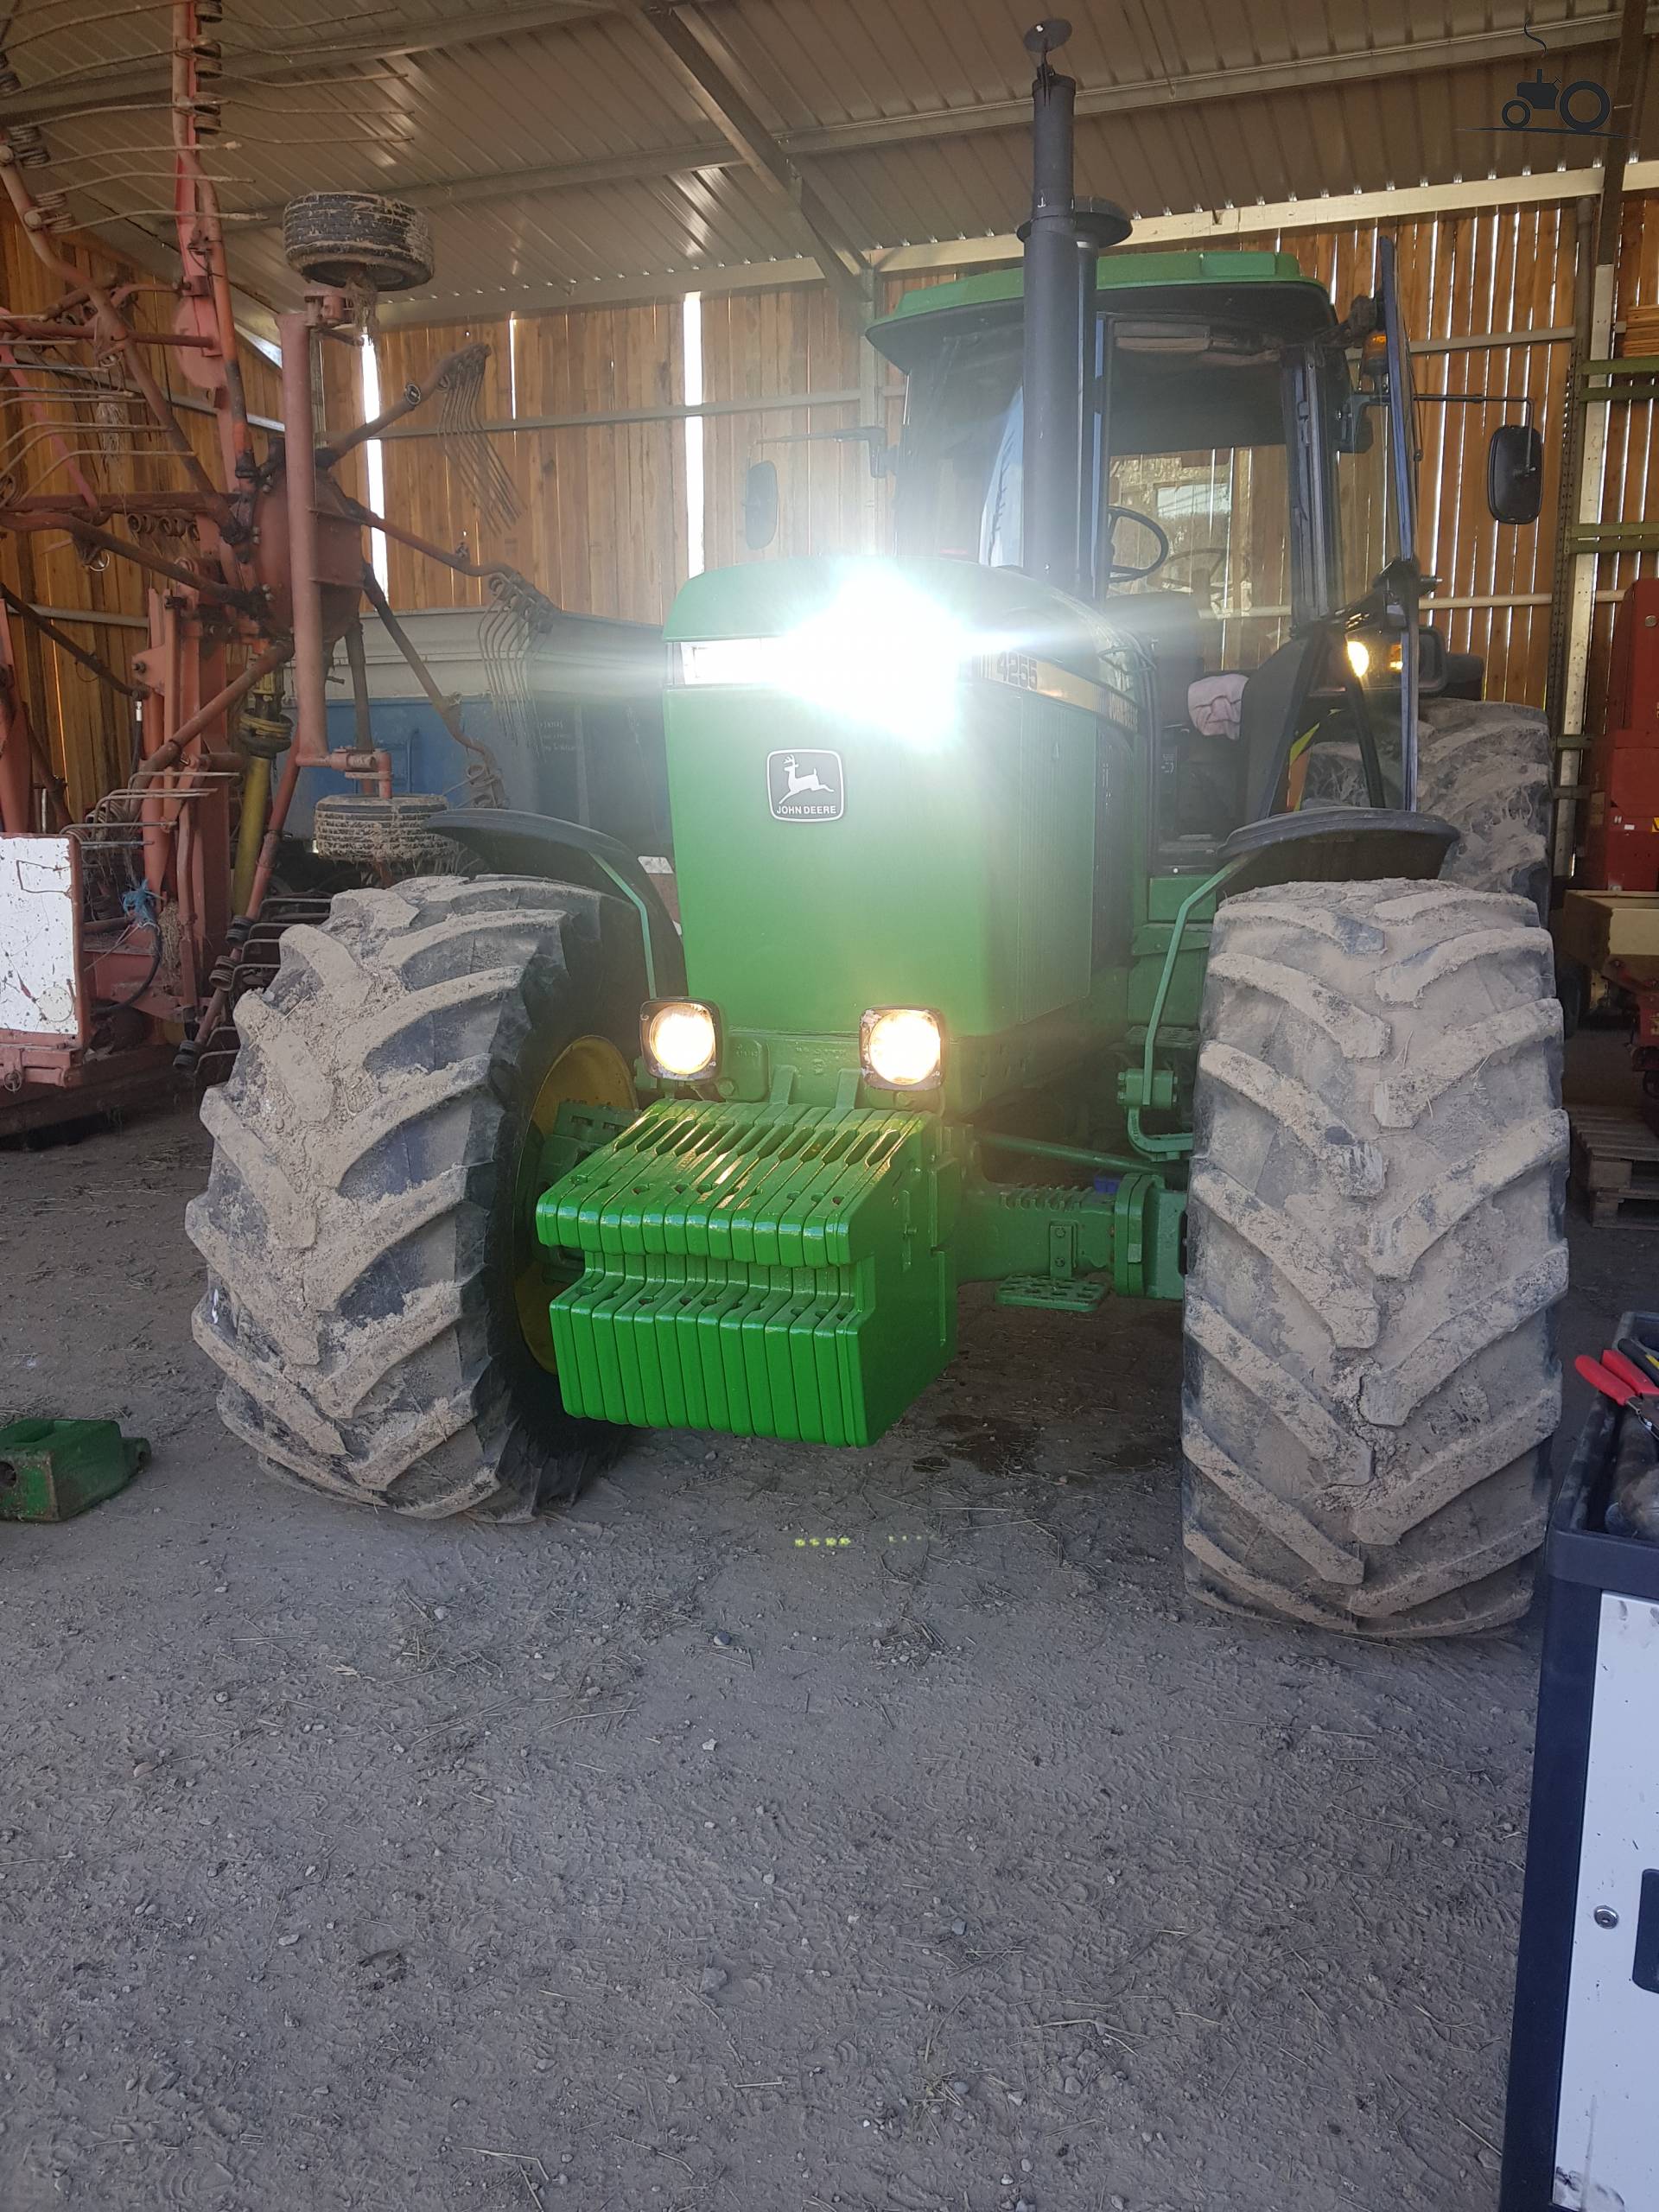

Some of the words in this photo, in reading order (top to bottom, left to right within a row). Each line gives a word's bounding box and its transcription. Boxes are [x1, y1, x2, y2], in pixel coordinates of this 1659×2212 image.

[996, 651, 1038, 690] 4255
[777, 805, 802, 814] JOHN
[804, 805, 836, 814] DEERE
